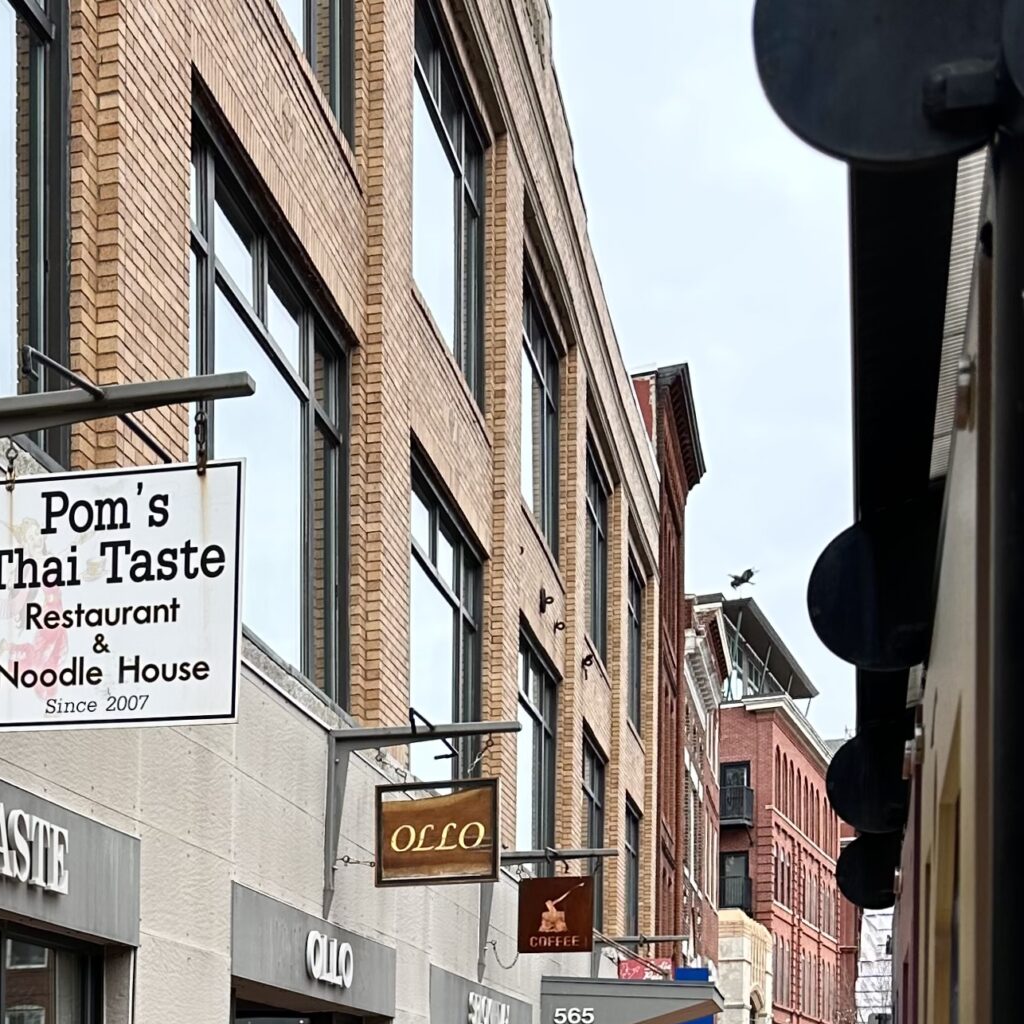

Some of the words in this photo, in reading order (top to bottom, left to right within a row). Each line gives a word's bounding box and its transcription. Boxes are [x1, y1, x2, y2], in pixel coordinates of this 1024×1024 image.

[40, 482, 170, 535] Pom's
[100, 539, 226, 584] Taste
[25, 597, 180, 630] Restaurant
[92, 633, 110, 654] &
[118, 655, 210, 684] House
[44, 698, 97, 714] Since
[105, 695, 149, 712] 2007
[391, 821, 485, 852] OLLO
[529, 935, 580, 948] COFFEE
[305, 930, 354, 989] OLLO
[554, 1008, 595, 1024] 565
